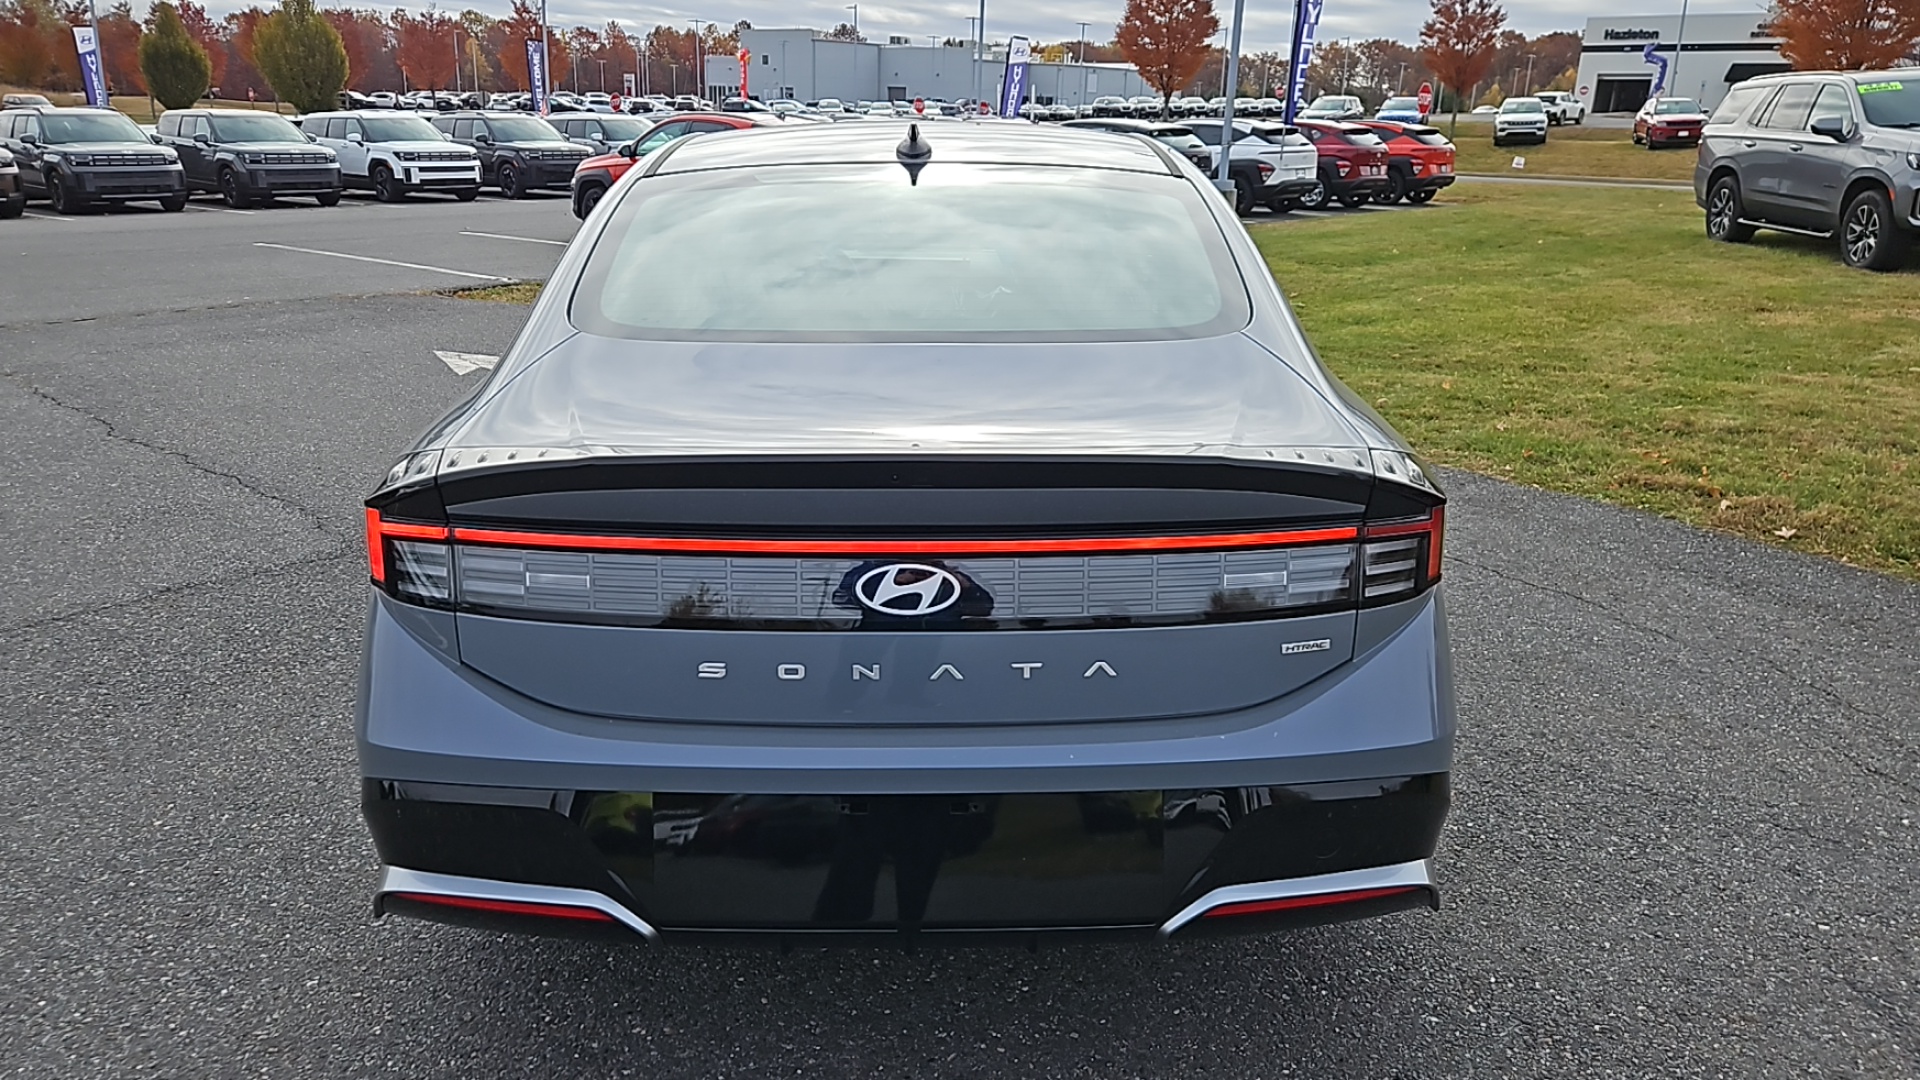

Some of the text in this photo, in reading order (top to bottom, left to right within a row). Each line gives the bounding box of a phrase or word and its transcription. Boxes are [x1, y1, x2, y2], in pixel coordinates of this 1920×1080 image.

[1604, 29, 1659, 40] Hazleton
[1418, 93, 1432, 104] STOP
[1285, 642, 1328, 652] HTRAC
[697, 661, 1118, 680] SONATA
